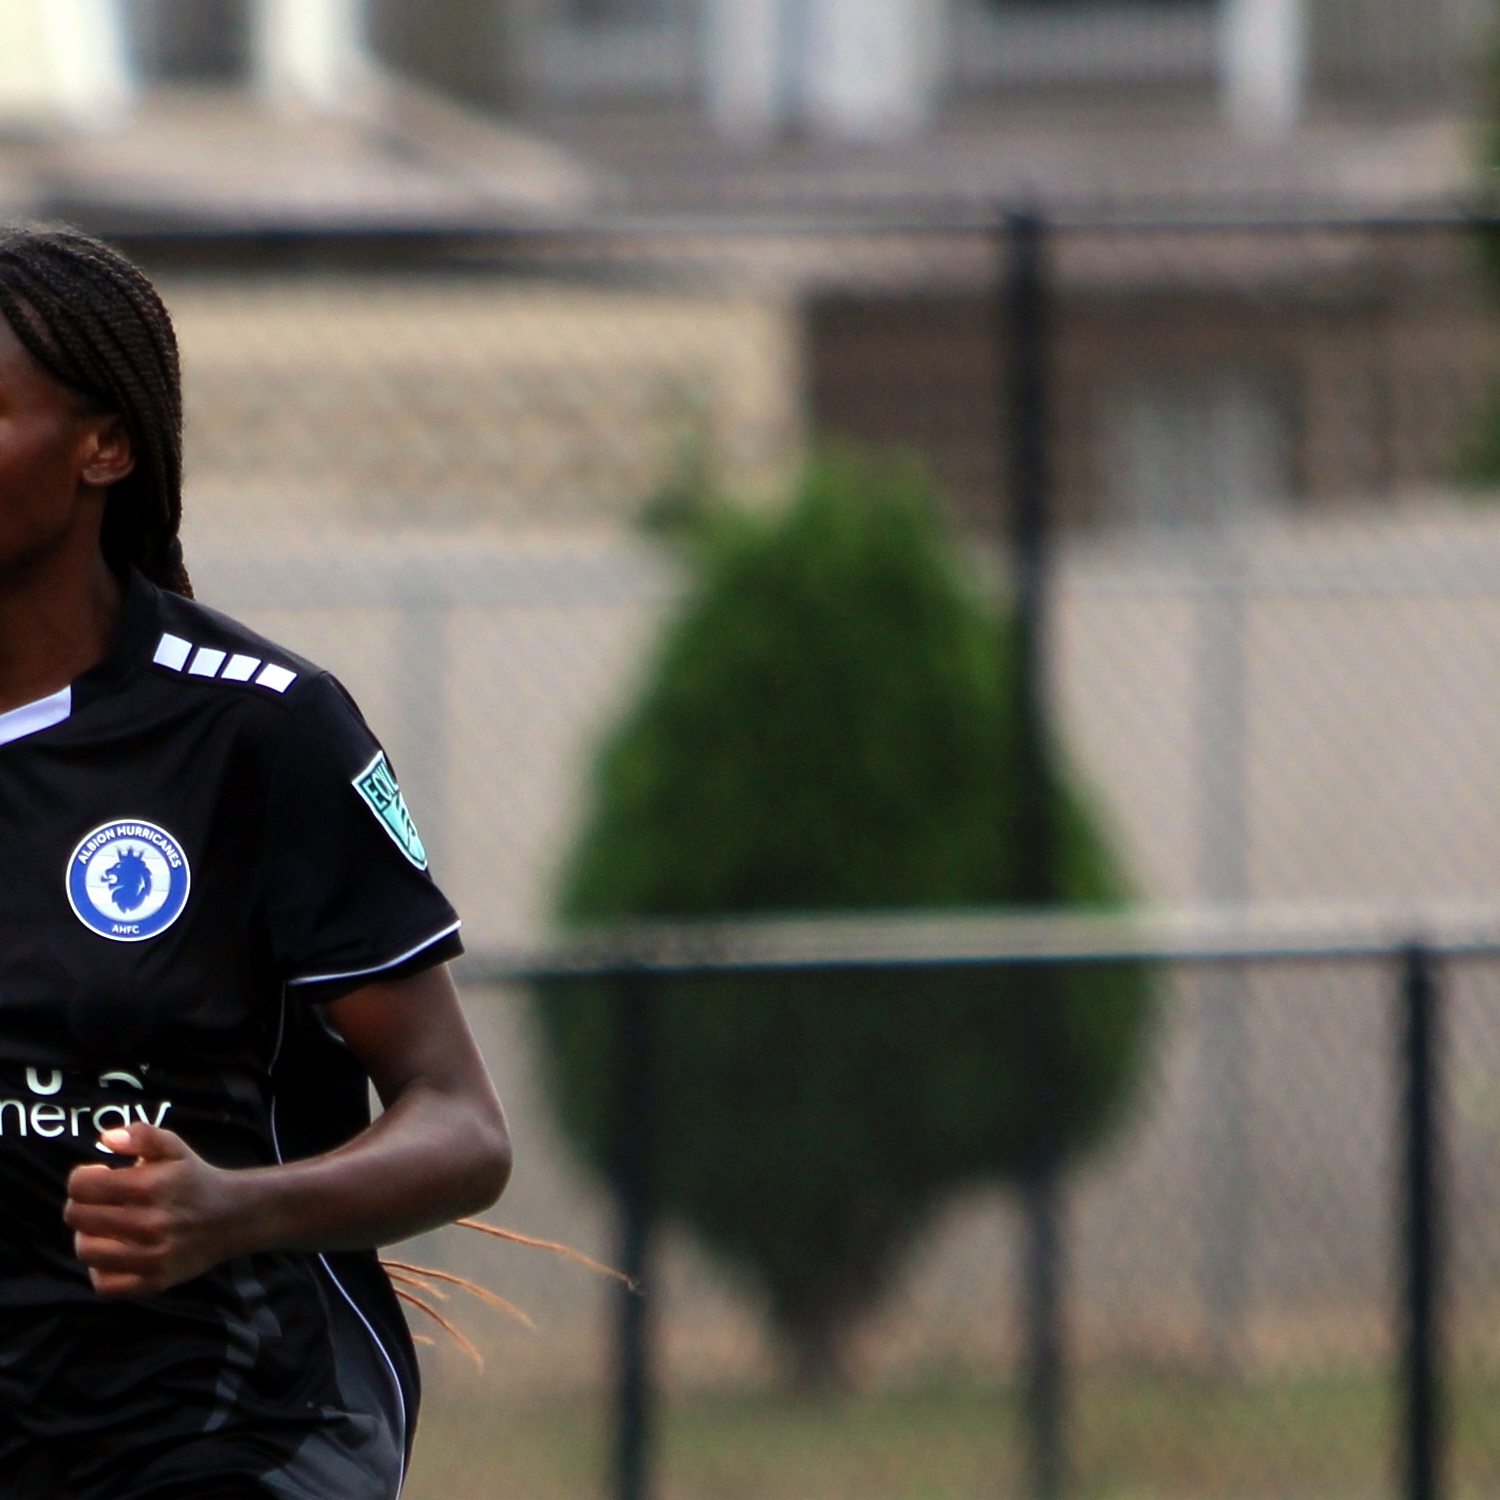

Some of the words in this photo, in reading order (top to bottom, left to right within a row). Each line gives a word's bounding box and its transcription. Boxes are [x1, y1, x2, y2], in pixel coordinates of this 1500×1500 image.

[78, 828, 116, 865] ALBION
[116, 825, 182, 869] HURRICANES
[111, 924, 140, 935] AHFC
